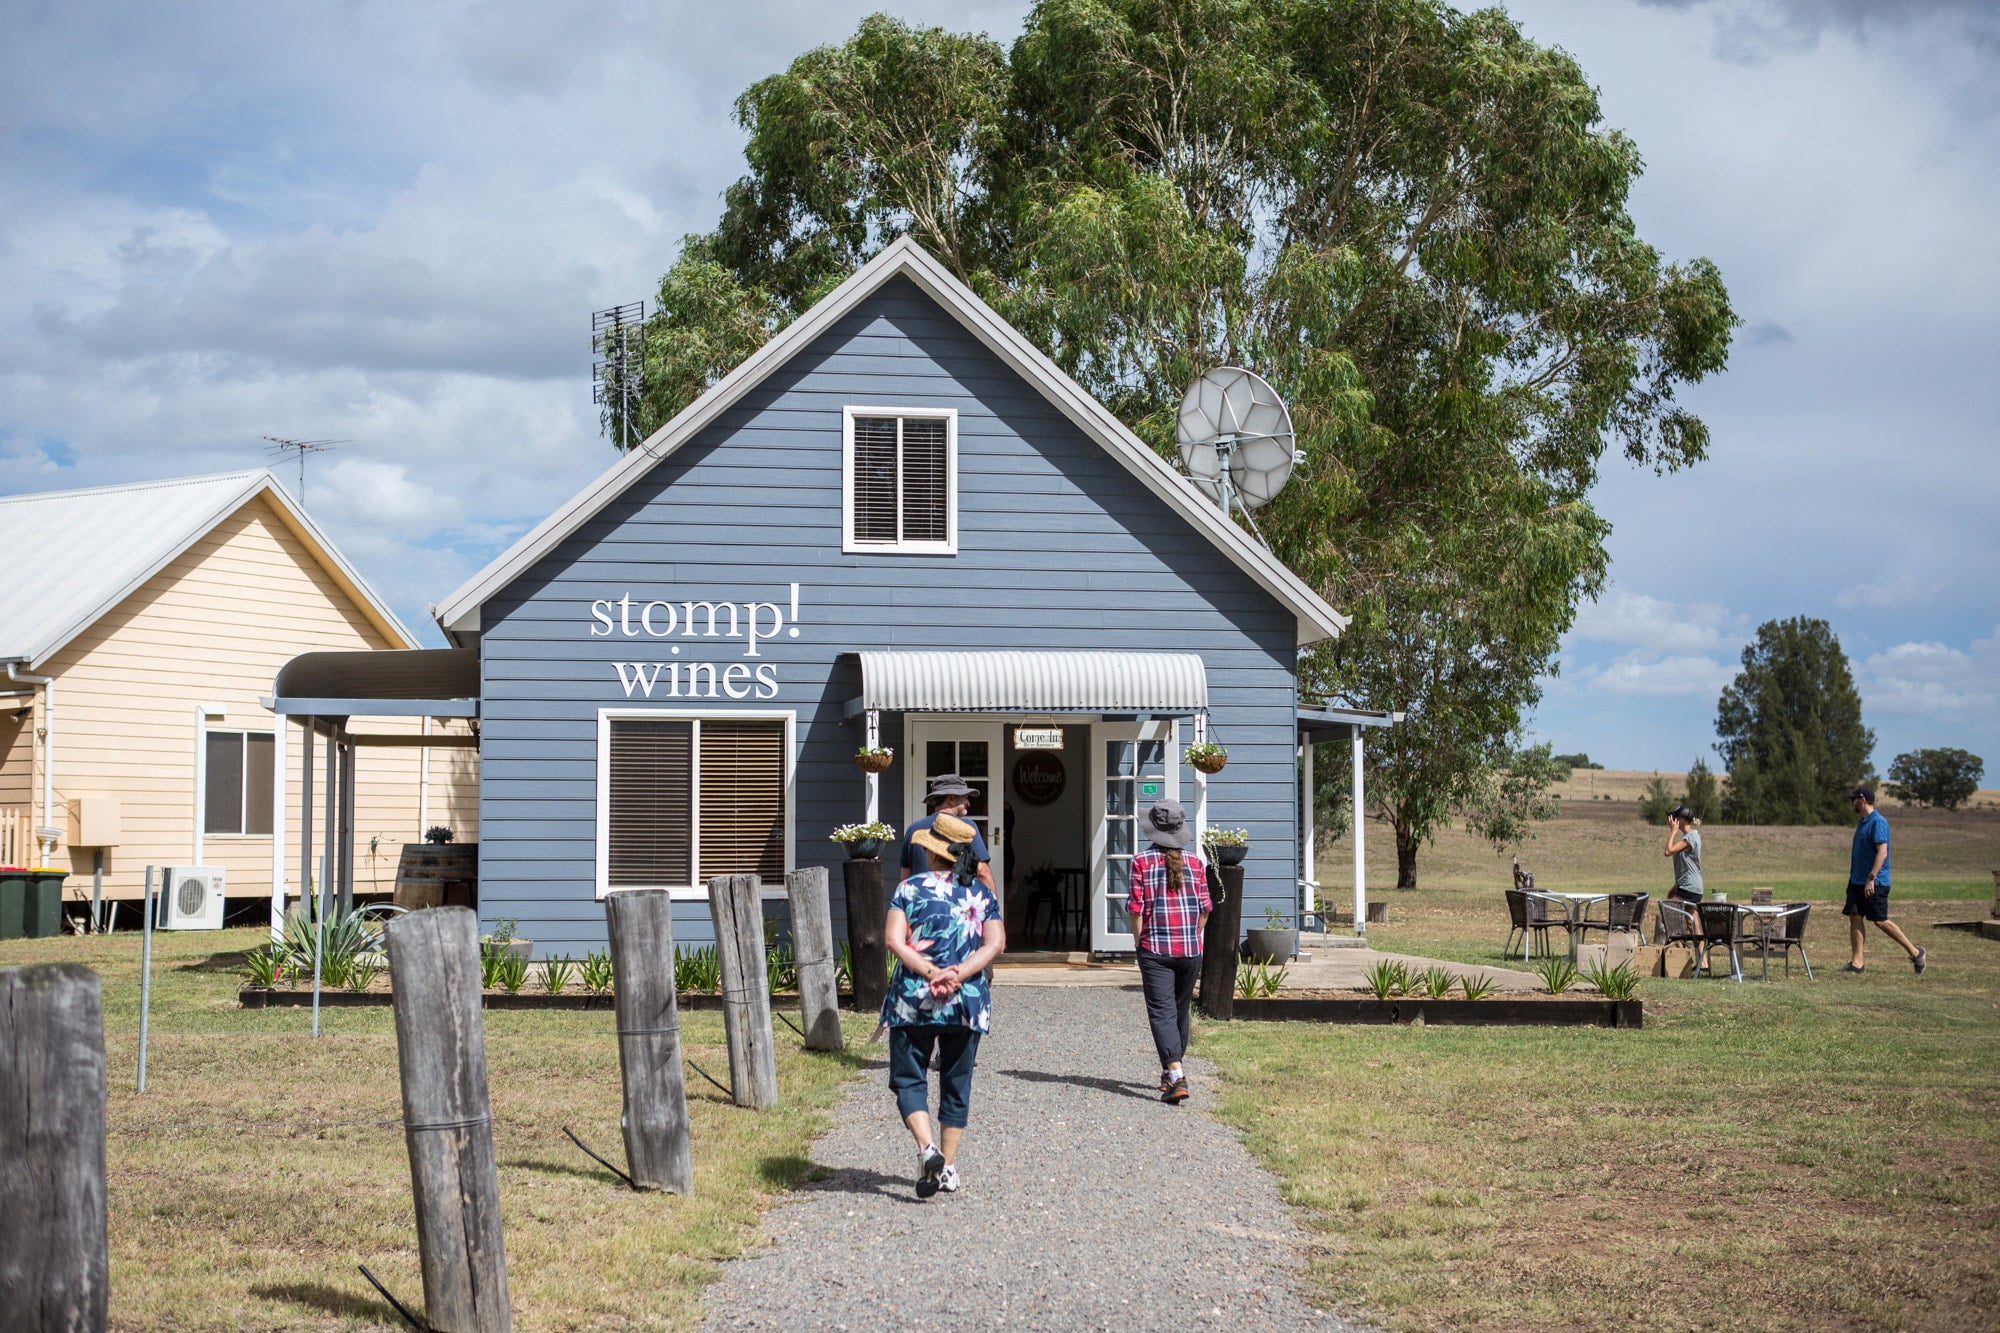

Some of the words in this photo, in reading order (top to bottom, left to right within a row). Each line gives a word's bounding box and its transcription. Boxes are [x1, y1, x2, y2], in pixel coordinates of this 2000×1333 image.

[590, 583, 800, 657] stomp!
[611, 646, 779, 699] wines
[1020, 730, 1046, 744] Come
[1049, 730, 1058, 743] In
[1019, 765, 1063, 784] Welcome
